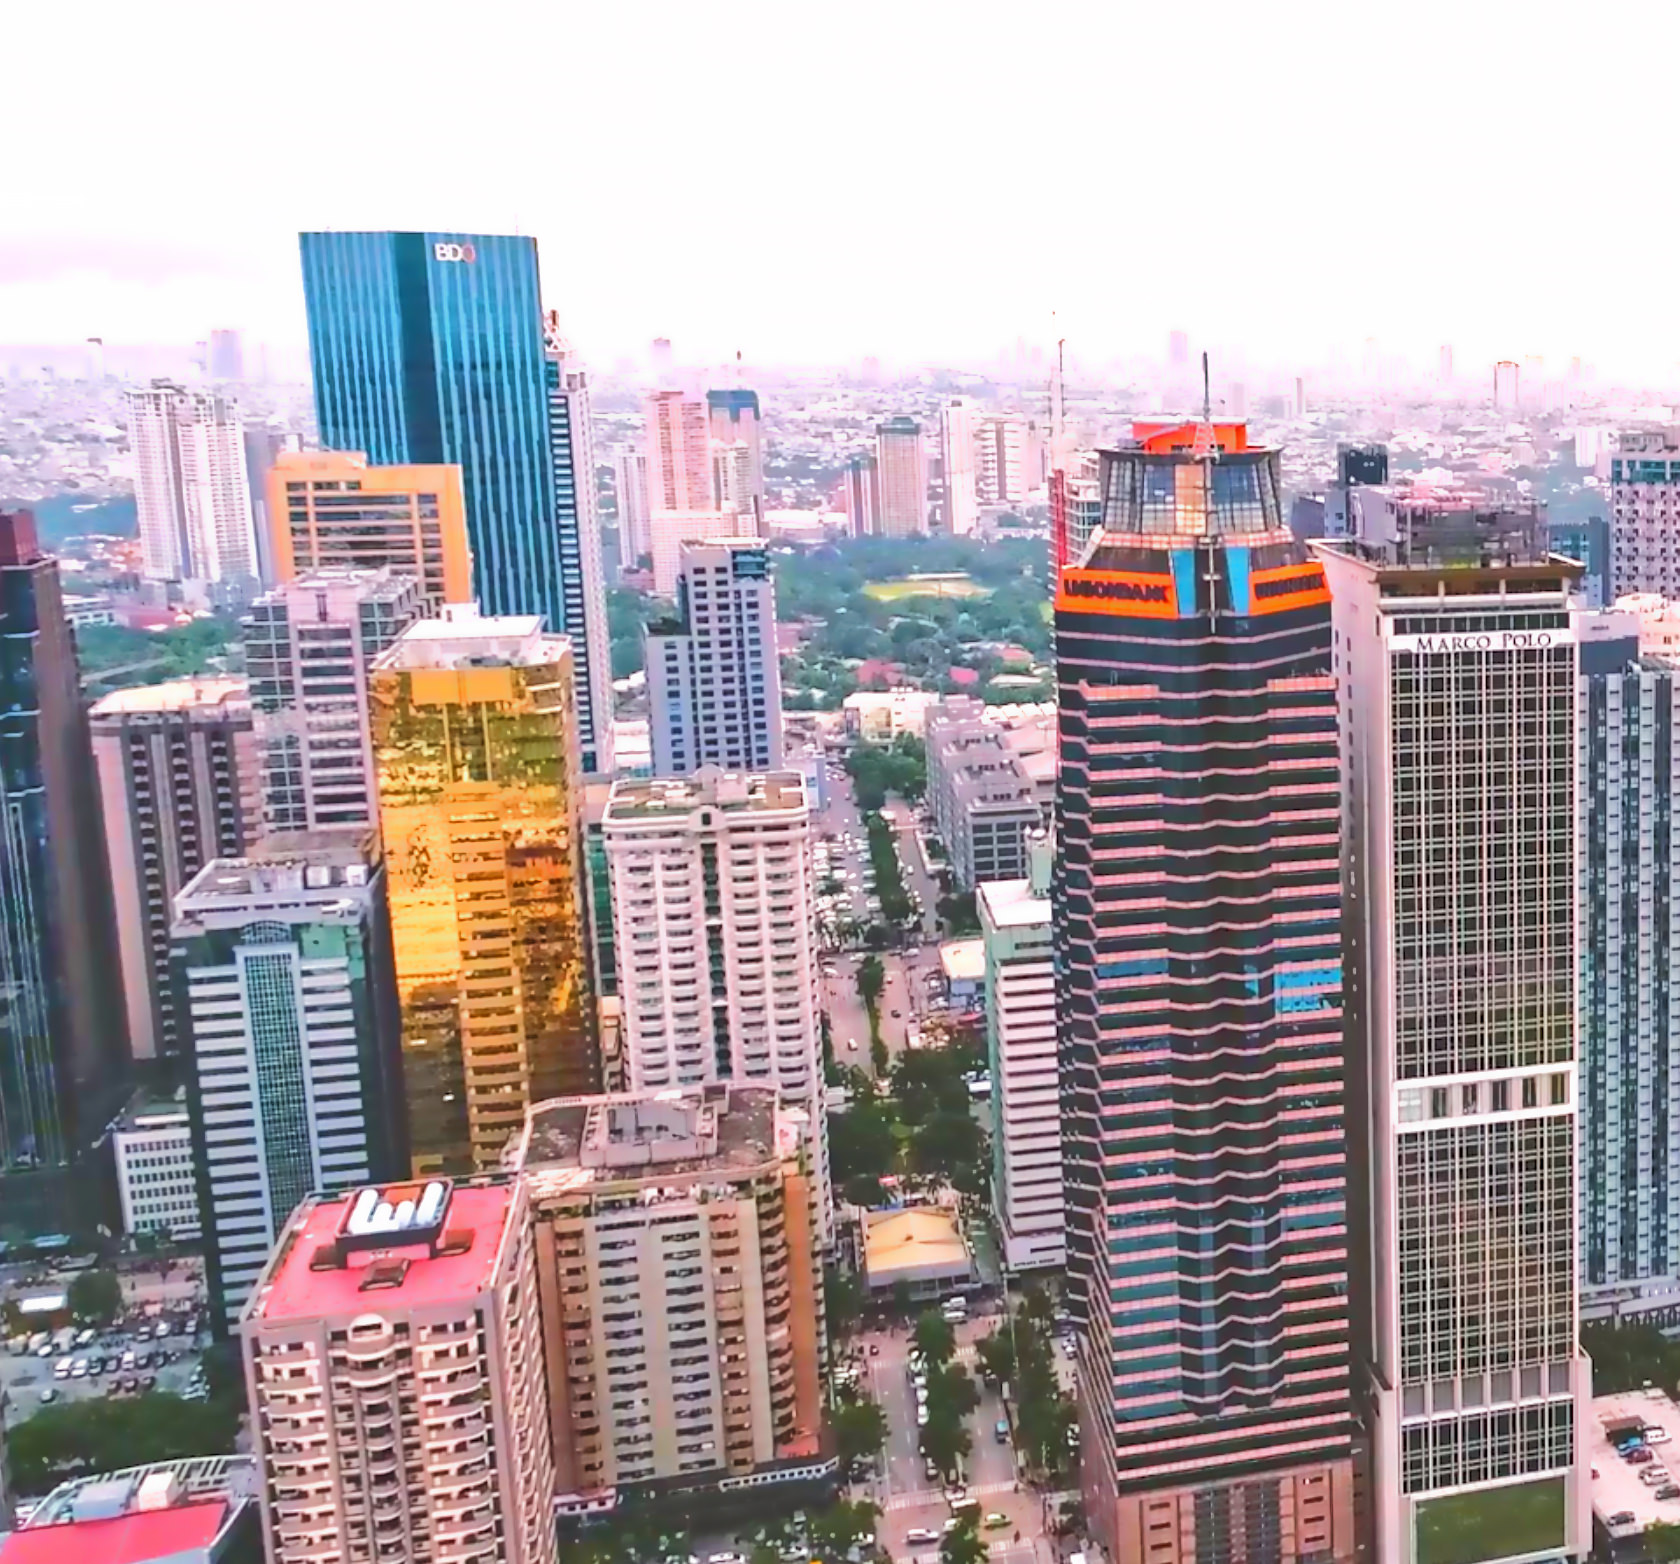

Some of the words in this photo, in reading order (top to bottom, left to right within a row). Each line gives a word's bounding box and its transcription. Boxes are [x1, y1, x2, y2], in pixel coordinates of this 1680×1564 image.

[434, 242, 476, 263] BDO
[1416, 635, 1491, 652] MARCO
[1502, 633, 1551, 650] POLO
